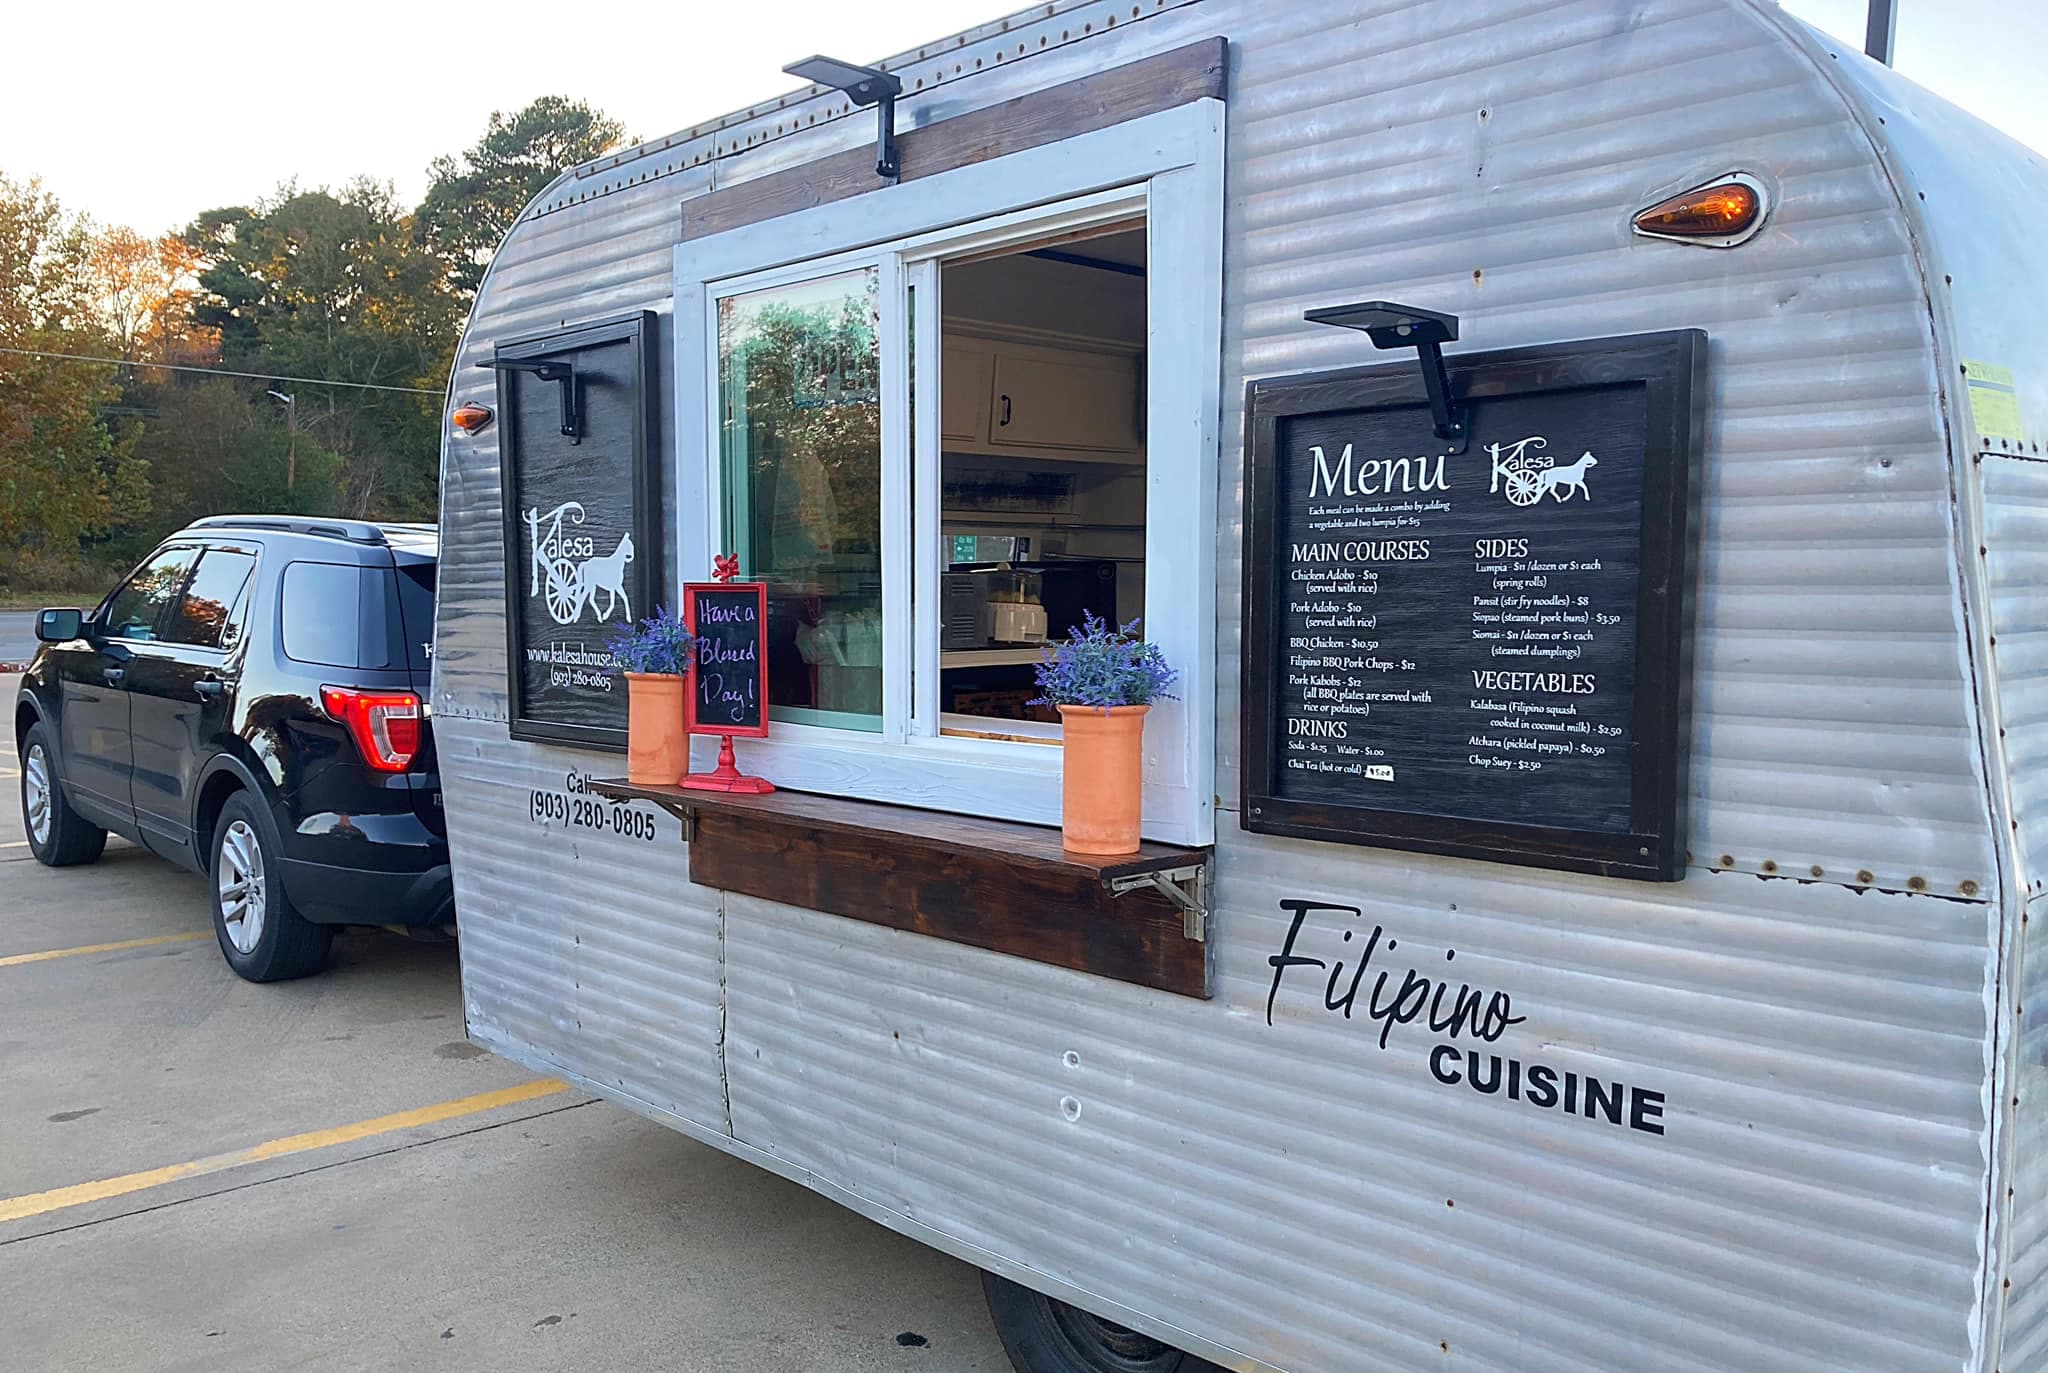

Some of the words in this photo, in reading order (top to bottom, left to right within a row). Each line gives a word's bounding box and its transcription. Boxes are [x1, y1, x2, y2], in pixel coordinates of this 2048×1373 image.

[1309, 443, 1450, 497] Menu
[1483, 436, 1555, 493] Kalesa
[522, 501, 594, 597] Kalesa
[1291, 543, 1340, 562] MAIN
[1344, 540, 1430, 561] COURSES
[1475, 538, 1528, 558] SIDES
[1291, 569, 1325, 581] Chicken
[1326, 568, 1355, 580] Adobo
[1476, 563, 1507, 575] Lumpia
[1581, 559, 1601, 570] each
[1306, 581, 1336, 594] (served
[1338, 582, 1356, 593] with
[1358, 581, 1377, 594] rice)
[1493, 577, 1524, 590] (spring
[1525, 576, 1547, 588] rolls)
[1291, 601, 1310, 612] Pork
[1311, 601, 1339, 612] Adobo
[1473, 596, 1498, 606] Pansit
[1500, 595, 1516, 608] (stir
[1517, 595, 1532, 609] fry
[1534, 595, 1570, 607] noodles)
[700, 599, 741, 624] Have
[745, 606, 754, 622] a
[1472, 612, 1500, 624] Siopao
[1501, 611, 1539, 623] (steamed
[1540, 611, 1561, 624] pork
[1563, 611, 1589, 624] buns)
[1306, 615, 1335, 629] (served
[1337, 615, 1356, 627] with
[1357, 615, 1376, 629] rice)
[1472, 629, 1499, 639] Siomai
[1573, 629, 1593, 641] each
[1290, 637, 1314, 651] BBQ
[1310, 636, 1344, 648] Chicken
[1491, 644, 1529, 657] (steamed
[1530, 645, 1581, 659] dumplings)
[1290, 655, 1321, 670] Filipino
[1323, 657, 1347, 671] BBQ
[1344, 656, 1364, 668] Pork
[1365, 657, 1394, 672] Chops
[550, 664, 571, 687] (903)
[572, 670, 612, 692] 280-0805
[1289, 674, 1308, 685] Pork
[1310, 674, 1341, 686] Kabobs
[1472, 670, 1595, 693] VEGETABLES
[700, 673, 754, 722] Day!
[1303, 687, 1317, 700] (all
[1319, 688, 1342, 702] BBQ
[1340, 688, 1364, 702] plates
[1381, 690, 1409, 702] served
[1411, 690, 1432, 702] with
[1304, 701, 1318, 712] rice
[1331, 703, 1369, 716] potatoes)
[1470, 699, 1507, 711] Kalabasa
[1509, 701, 1545, 715] (Filipino
[1546, 704, 1576, 716] squash
[1288, 718, 1347, 738] DRINKS
[1490, 717, 1519, 729] cooked
[1521, 719, 1529, 729] in
[1531, 722, 1565, 732] coconut
[1567, 722, 1591, 734] milk)
[1288, 740, 1305, 750] Soda
[1337, 745, 1360, 754] Water
[1503, 737, 1537, 750] (pickled
[1538, 741, 1573, 755] papaya)
[1288, 759, 1304, 768] Chai
[1305, 760, 1318, 769] Tea
[1319, 761, 1333, 773] (hot
[1344, 764, 1361, 775] cold)
[1469, 754, 1491, 768] Chop
[1492, 756, 1512, 770] Suey
[530, 790, 570, 827] (903)
[573, 799, 656, 841] 280-0805
[1267, 899, 1527, 1050] Filipino
[1429, 1045, 1666, 1136] CUISINE
